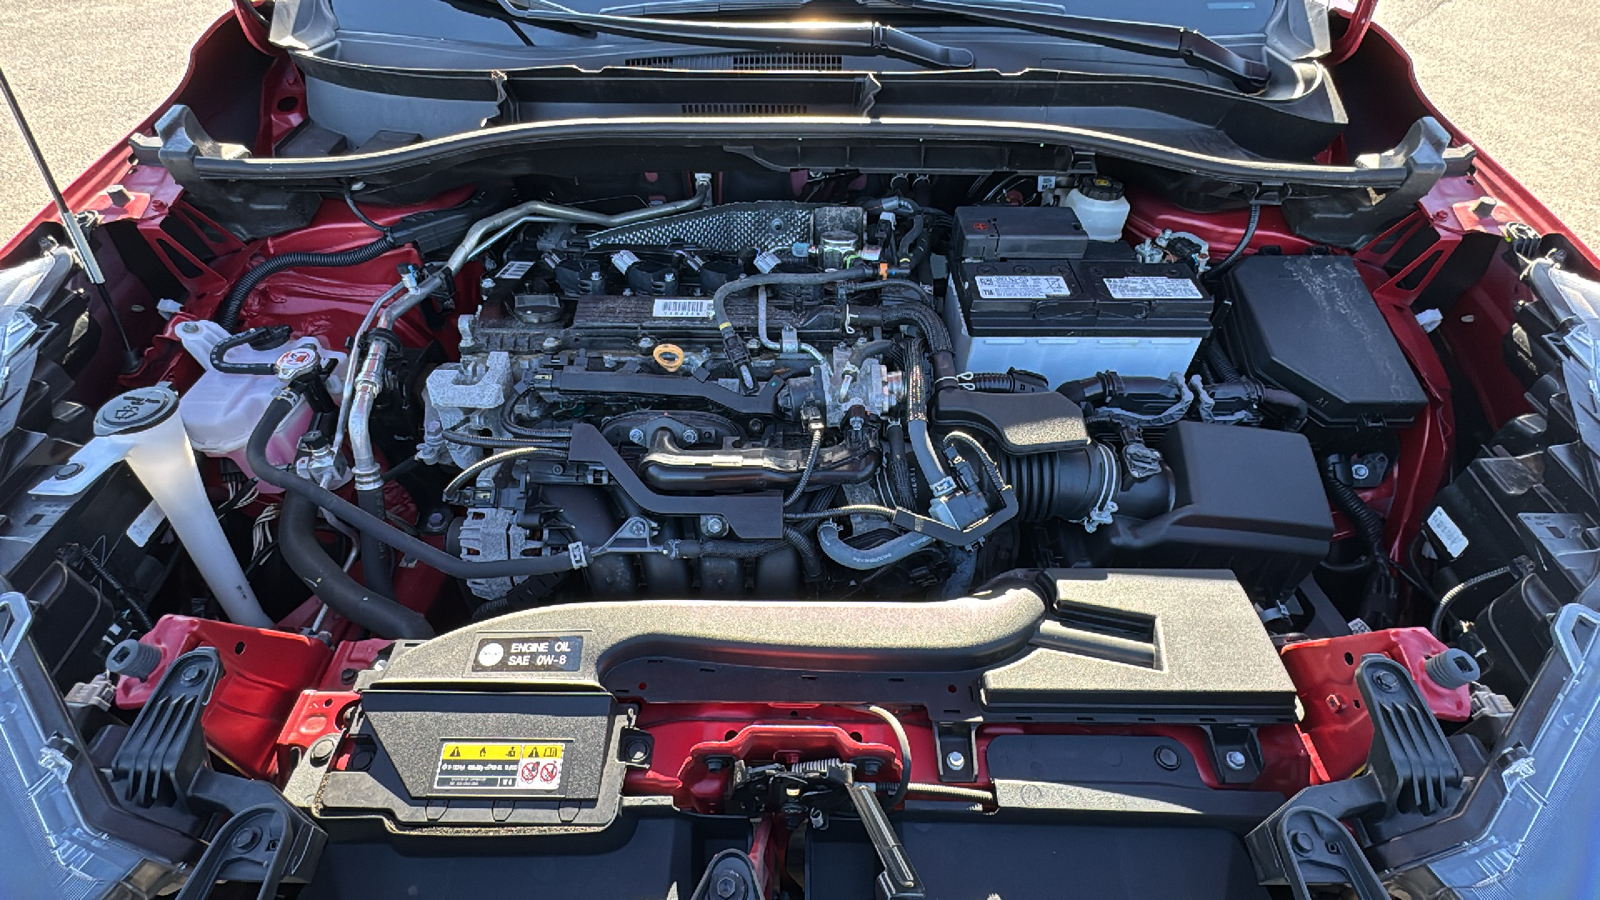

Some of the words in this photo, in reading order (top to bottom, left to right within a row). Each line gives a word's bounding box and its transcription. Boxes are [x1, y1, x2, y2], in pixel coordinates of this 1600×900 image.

[510, 641, 549, 653] ENGINE
[554, 641, 572, 652] OIL
[507, 655, 531, 666] SAE
[536, 654, 567, 666] 0W-8
